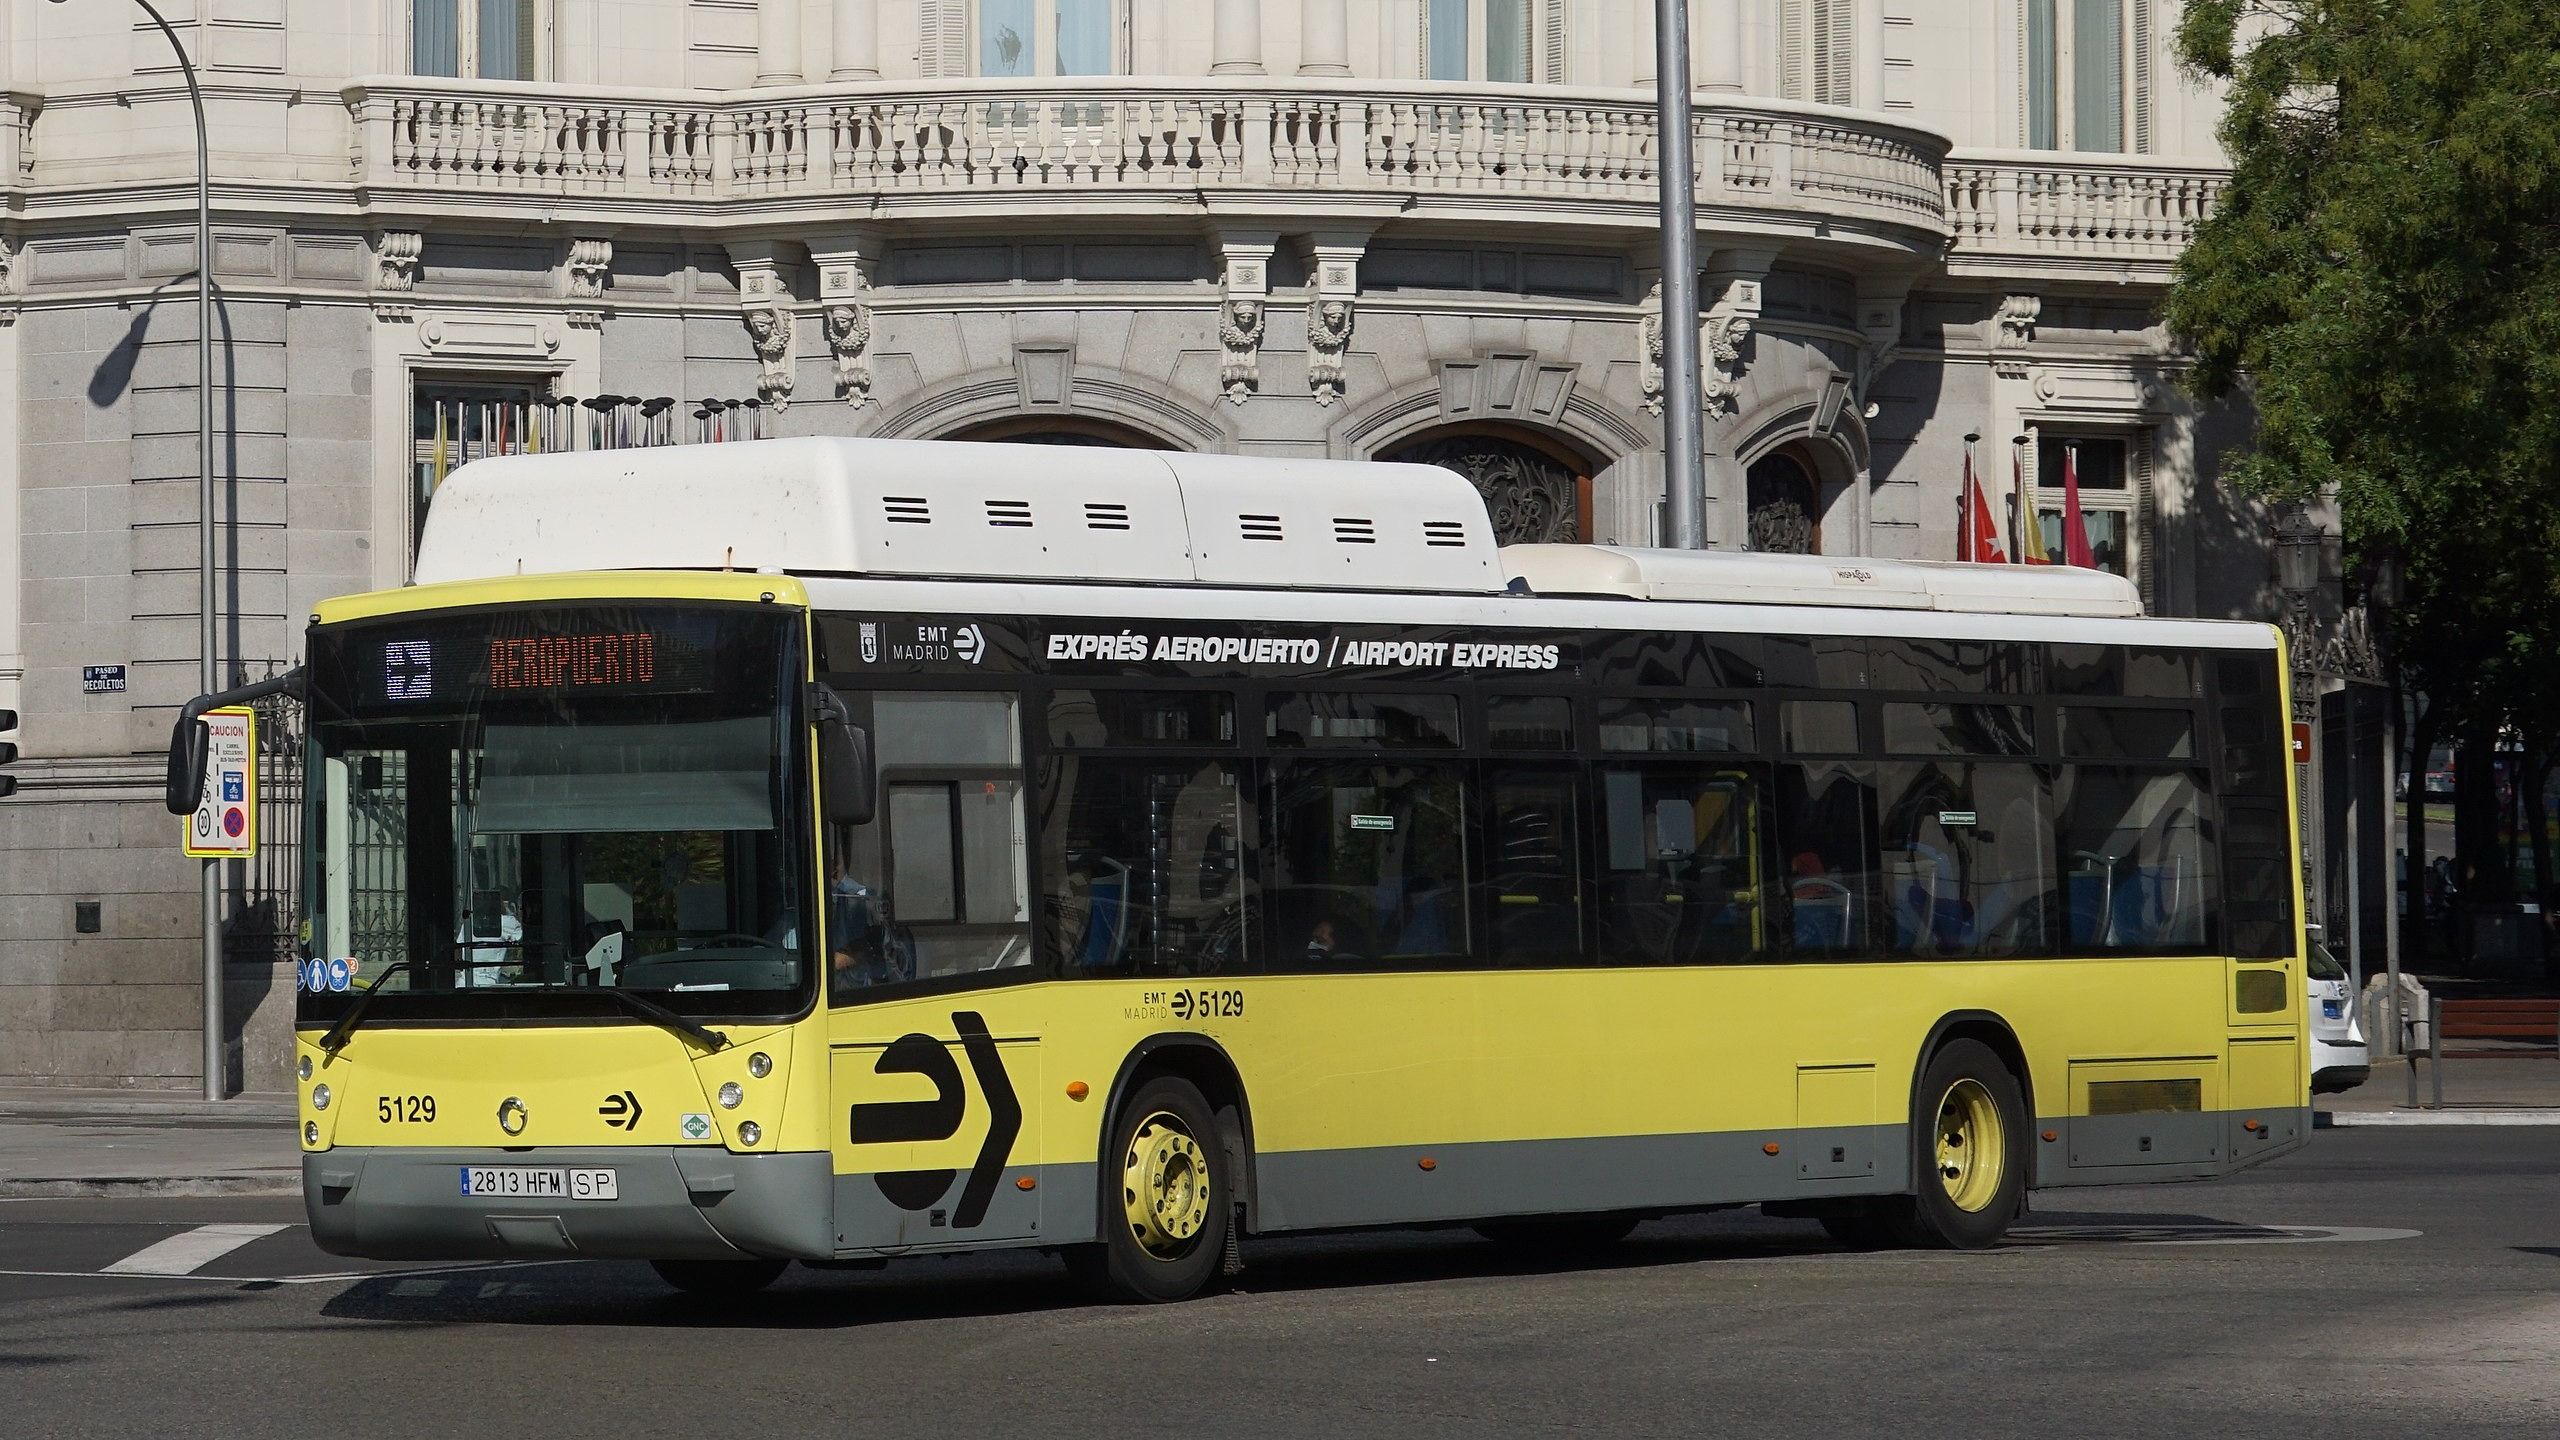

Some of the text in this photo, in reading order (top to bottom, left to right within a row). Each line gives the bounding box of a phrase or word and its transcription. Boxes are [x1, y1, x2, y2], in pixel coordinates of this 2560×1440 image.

[918, 626, 948, 642] EMT
[893, 645, 949, 660] MADRID
[1047, 630, 1559, 669] EXPRÉS AEROPUERTO / AIRPORT EXPRESS
[489, 633, 654, 688] AEROPUERTO
[84, 679, 125, 690] RECOLETOS
[210, 725, 244, 737] CAUCION
[201, 815, 208, 829] 30
[1144, 992, 1167, 1004] EMT
[1199, 990, 1244, 1018] 5129
[1124, 1007, 1168, 1020] MADRID
[378, 1095, 436, 1123] 5129
[688, 1122, 705, 1131] GNC
[475, 1171, 561, 1194] 2813 HFM
